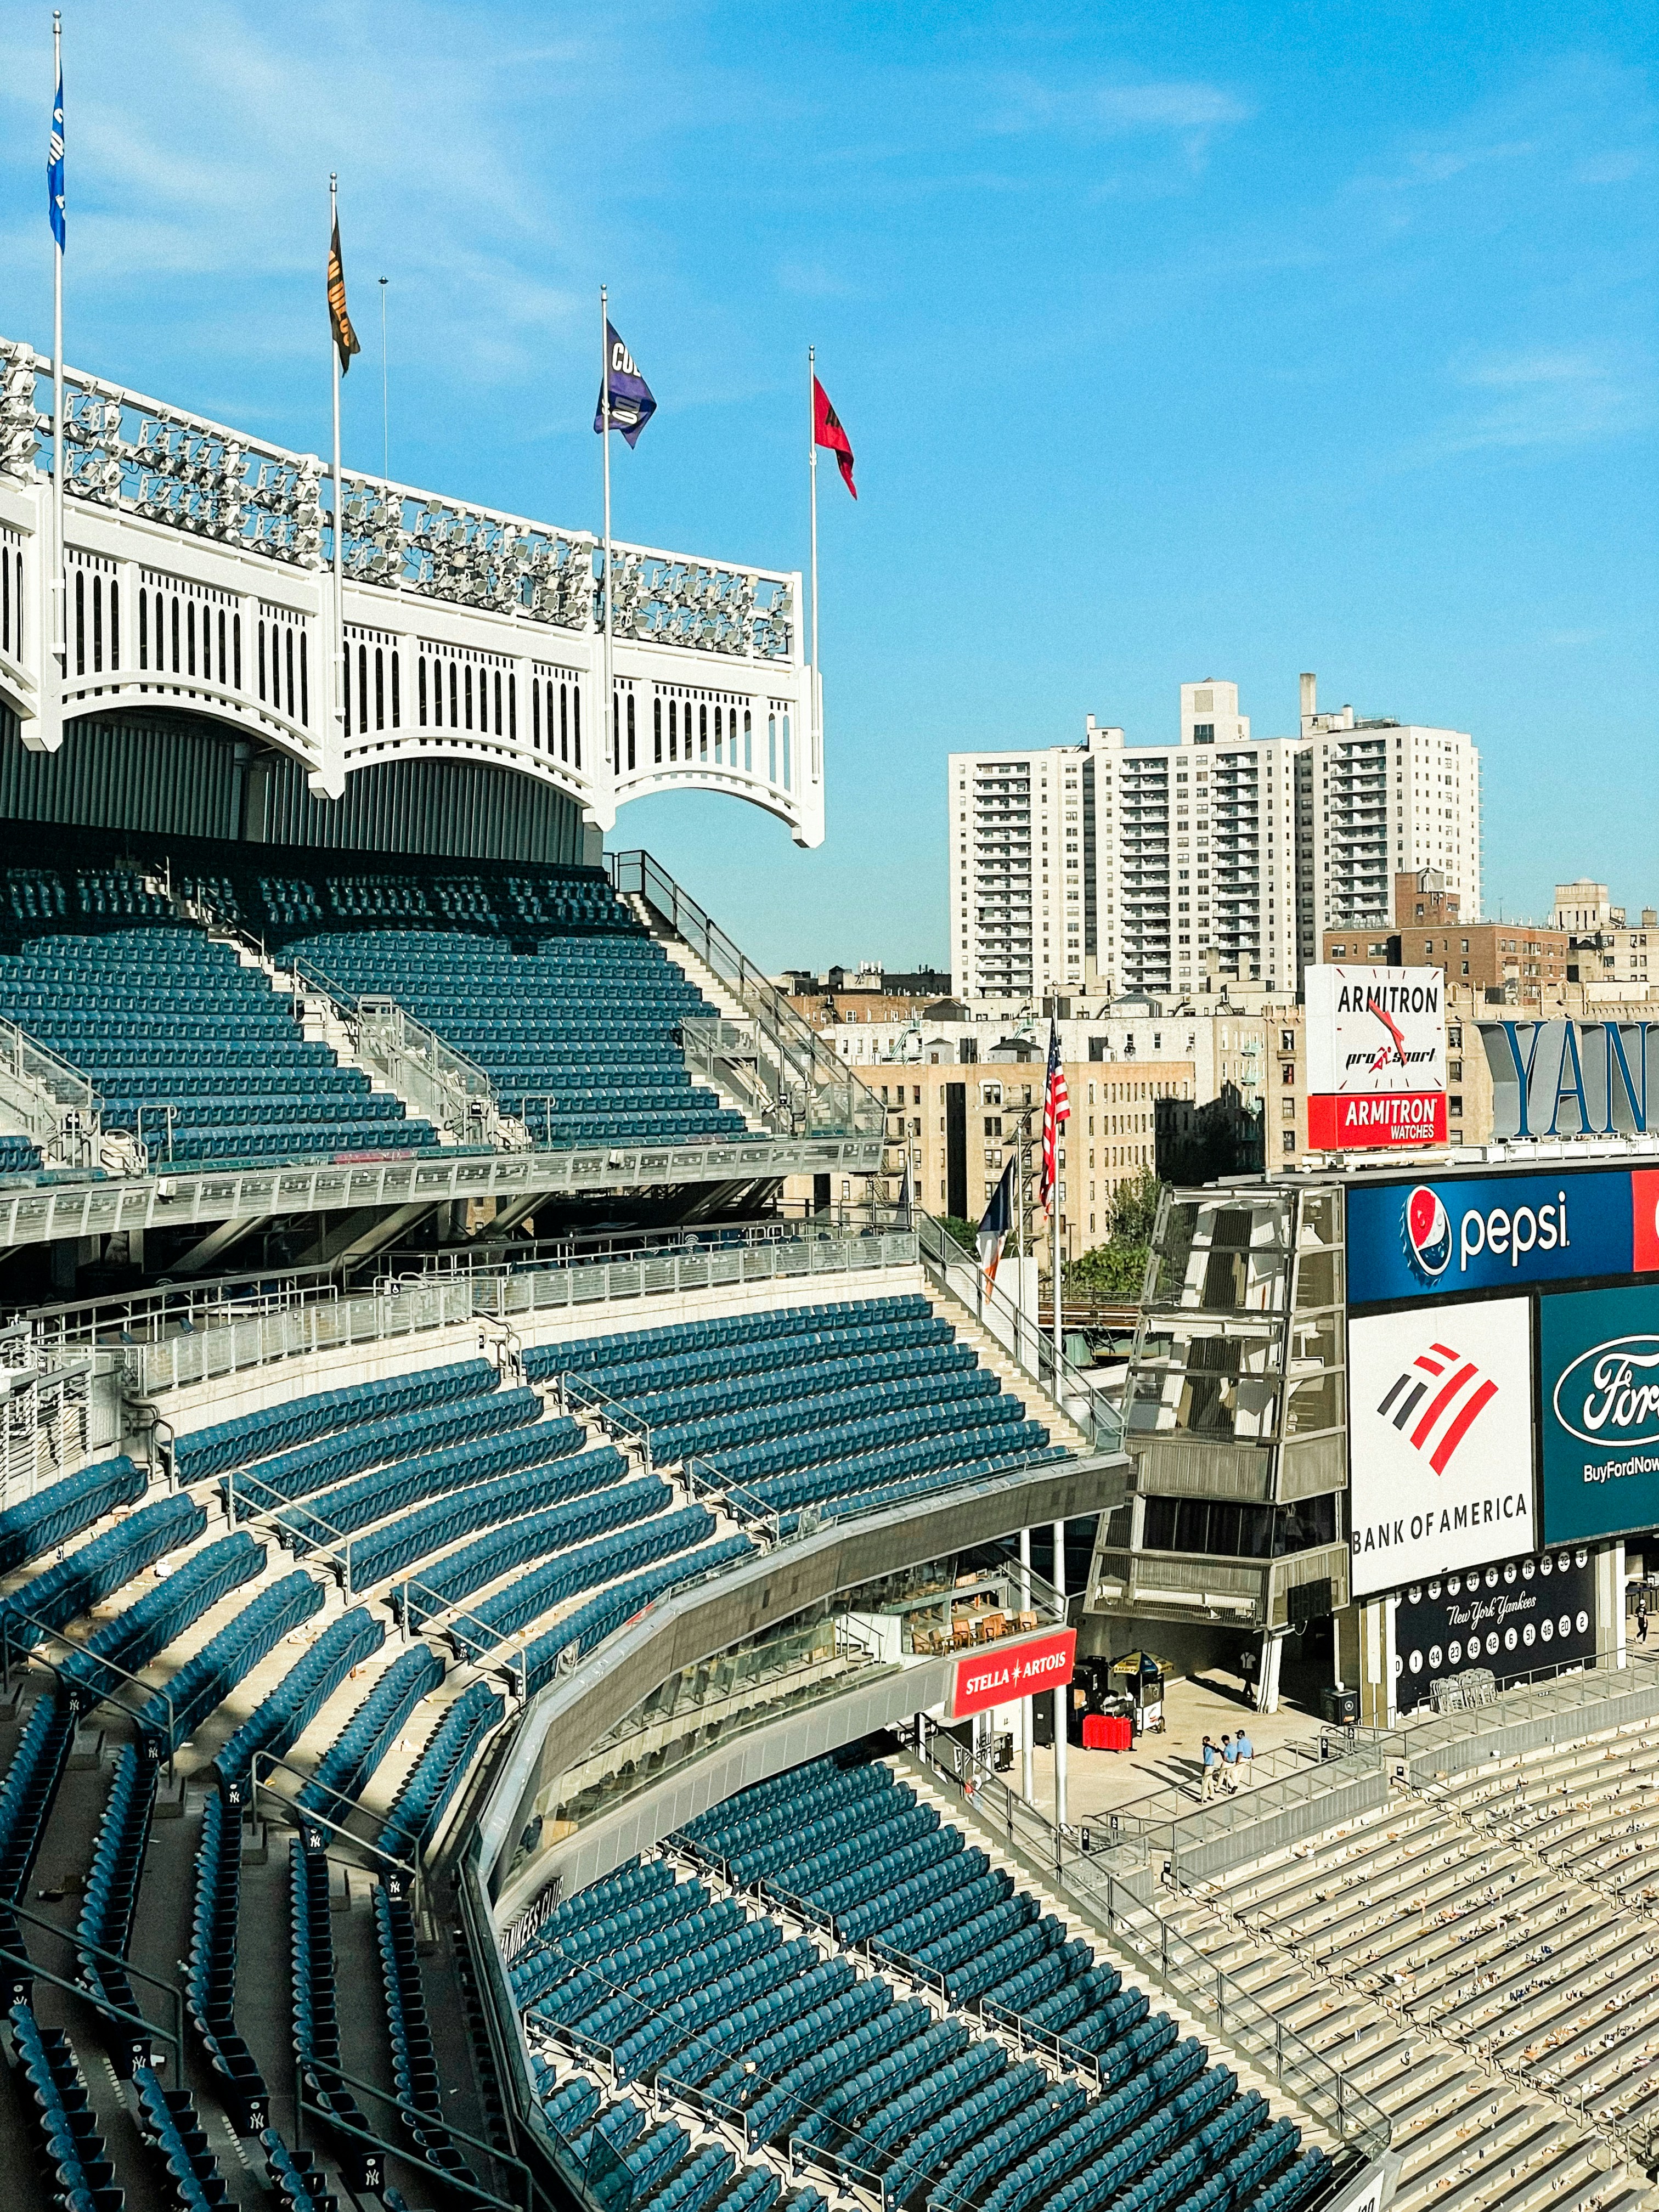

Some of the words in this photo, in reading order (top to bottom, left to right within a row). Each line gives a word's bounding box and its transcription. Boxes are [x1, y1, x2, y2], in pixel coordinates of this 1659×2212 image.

[1338, 986, 1437, 1013] ARMITRON
[1346, 1053, 1376, 1070] pro
[1345, 1098, 1435, 1126] ARMITRON
[1391, 1124, 1434, 1139] WATCHES
[1460, 1190, 1568, 1272] pepsi
[1583, 1353, 1659, 1430] For
[1352, 1520, 1404, 1555] BANK
[1411, 1512, 1434, 1539] OF
[1440, 1493, 1527, 1533] AMERICA
[1446, 1605, 1471, 1626] New
[1471, 1597, 1497, 1630] York
[1497, 1590, 1537, 1624] Yankees
[1431, 1650, 1440, 1663] 44
[1451, 1646, 1459, 1658] 23
[1469, 1642, 1478, 1654] 49
[1488, 1637, 1497, 1649] 42
[1526, 1629, 1533, 1640] 51
[1543, 1624, 1551, 1635] 46
[1561, 1620, 1568, 1632] 20
[966, 1668, 1009, 1695] STELLA
[1023, 1651, 1066, 1678] ARTOIS
[501, 1900, 540, 1965] ANKEES
